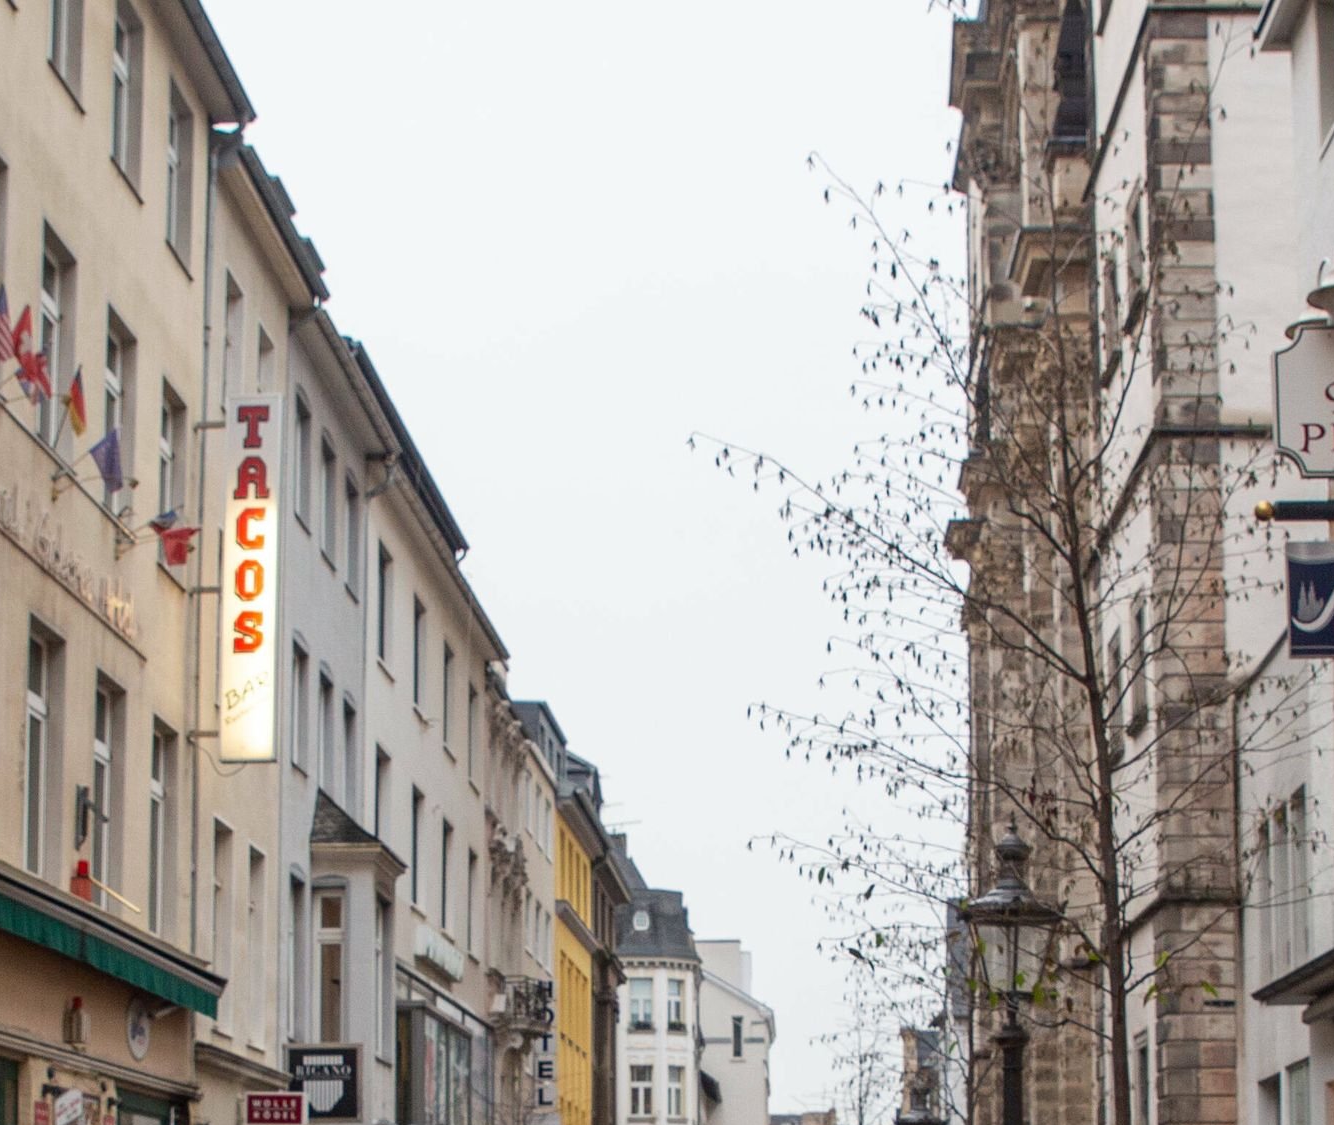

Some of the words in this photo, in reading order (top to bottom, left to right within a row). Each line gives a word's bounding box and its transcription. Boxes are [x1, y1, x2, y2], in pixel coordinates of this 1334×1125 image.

[232, 404, 272, 654] TACOS
[251, 1098, 298, 1109] WOLLE
[251, 1109, 298, 1121] RÖDEL
